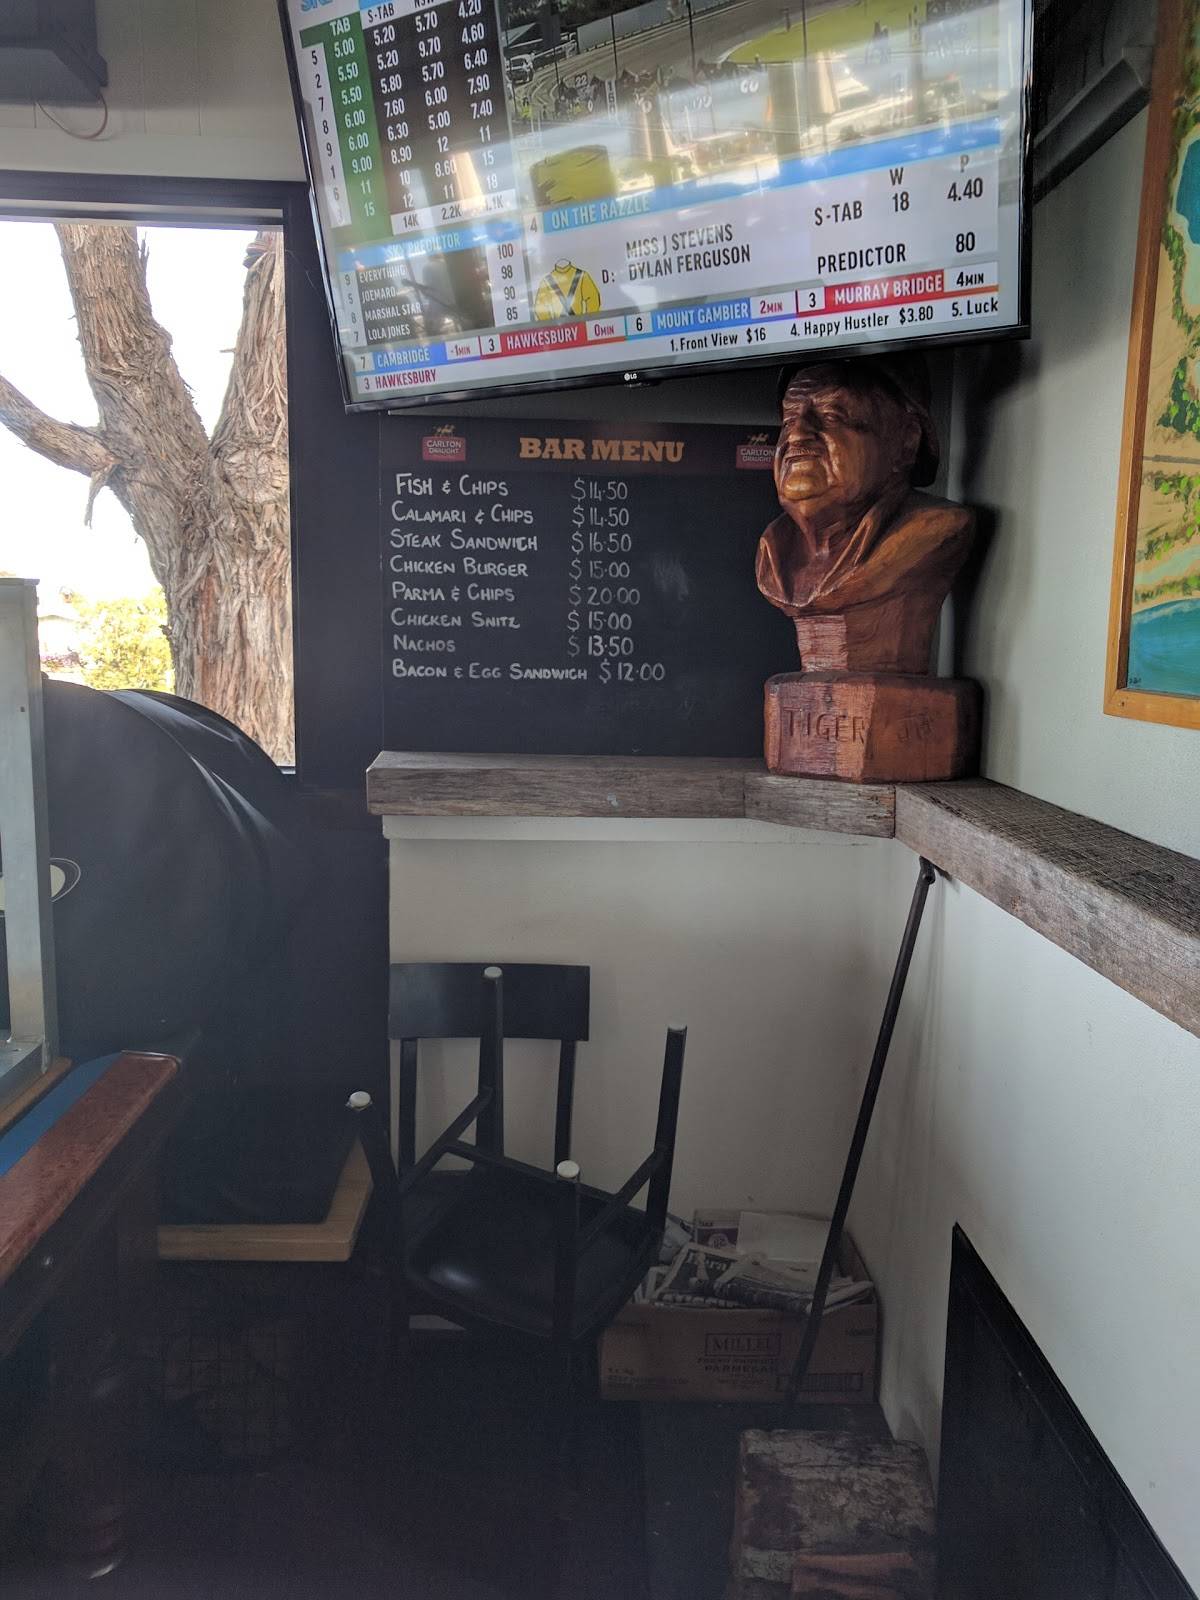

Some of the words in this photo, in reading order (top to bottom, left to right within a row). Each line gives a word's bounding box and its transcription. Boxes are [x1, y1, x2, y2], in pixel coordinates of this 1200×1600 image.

[311, 50, 318, 65] 5
[334, 37, 355, 58] 5.00
[373, 24, 396, 46] 5.20
[415, 11, 438, 33] 5.70
[458, 0, 482, 18] 4.20
[329, 17, 351, 37] TAB
[367, 2, 395, 23] S-TAB
[315, 73, 322, 89] 2
[337, 61, 359, 82] 5.50
[377, 49, 399, 71] 5.20
[418, 36, 441, 58] 9.70
[461, 22, 485, 45] 4.60
[318, 96, 324, 112] 7
[341, 85, 362, 105] 5.50
[380, 73, 403, 94] 5.80
[421, 61, 444, 82] 5.70
[464, 48, 488, 70] 6.40
[322, 119, 329, 135] 8
[344, 109, 366, 129] 6.00
[383, 97, 405, 118] 7.60
[425, 86, 448, 107] 6.00
[467, 73, 490, 96] 7.90
[326, 142, 333, 157] 9
[348, 132, 369, 152] 6.00
[387, 121, 409, 141] 6.30
[428, 110, 451, 130] 5.00
[470, 99, 493, 120] 7.40
[330, 165, 336, 179] 1
[351, 155, 373, 174] 9.00
[390, 145, 412, 165] 8.90
[437, 136, 449, 153] 12
[479, 124, 491, 143] 11
[360, 179, 372, 195] 11
[399, 169, 411, 186] 10
[434, 159, 457, 178] 8.60
[482, 150, 495, 166] 15
[889, 167, 905, 186] W
[959, 154, 970, 173] P
[364, 201, 376, 217] 15
[402, 192, 414, 209] 12
[442, 183, 455, 200] 11
[486, 173, 498, 190] 18
[814, 200, 863, 227] S-TAB
[892, 191, 910, 213] 18
[947, 177, 984, 202] 4.40
[402, 213, 420, 229] 14K
[441, 203, 462, 220] 2.2K
[529, 217, 538, 233] 4
[551, 208, 570, 230] ON
[571, 203, 597, 226] THE
[600, 194, 651, 221] RAZZLE
[497, 243, 514, 260] 100
[625, 236, 660, 260] MISS
[662, 235, 668, 255] J
[671, 223, 733, 251] STEVENS
[817, 243, 907, 275] PREDICTOR
[955, 231, 976, 254] 80
[501, 265, 513, 280] 98
[602, 268, 616, 285] D:
[628, 257, 674, 282] DYLAN
[677, 244, 751, 273] FERGUSON
[360, 356, 366, 369] 7
[377, 348, 431, 368] CAMBRIDGE
[488, 338, 495, 352] 3
[506, 326, 579, 350] HAWKESBURY
[635, 317, 643, 332] 6
[656, 310, 695, 330] MOUNT
[697, 302, 750, 323] GAMBIER
[808, 292, 817, 308] 3
[834, 281, 889, 305] MURRAY
[893, 274, 944, 297] BRIDGE
[364, 305, 401, 322] MARSHAL
[401, 302, 422, 316] STAR
[503, 286, 516, 300] 90
[353, 331, 359, 343] 7
[367, 327, 387, 341] LOLA
[387, 323, 411, 339] JONES
[506, 307, 518, 320] 85
[364, 378, 371, 390] 3
[375, 368, 437, 390] HAWKESBURY
[680, 335, 708, 351] Front
[710, 332, 738, 347] View
[746, 327, 767, 345] $16
[790, 323, 801, 338] 4.
[804, 318, 841, 338] Happy
[844, 312, 890, 331] Hustler
[899, 305, 934, 325] $3.80
[951, 302, 963, 317] 5.
[966, 297, 999, 315] Luck
[426, 440, 462, 449] CARLTON
[519, 437, 586, 460] BAR
[591, 439, 685, 463] MENU
[740, 448, 775, 457] CARLTON
[396, 472, 433, 496] FISH
[441, 480, 451, 495] &
[459, 474, 509, 497] CHIPS
[391, 500, 466, 524] CALAMARI
[474, 508, 485, 525] &
[490, 503, 534, 525] CHIPS
[390, 528, 442, 549] STEAK
[449, 527, 538, 551] SANDWICH
[390, 554, 456, 575] CHICKEN
[463, 556, 528, 577] BURGER
[392, 581, 446, 602] PARMA
[450, 585, 461, 602] &
[467, 583, 515, 602] CHIPS
[390, 607, 462, 627] CHICKEN
[471, 611, 521, 630] SNITZ
[393, 634, 456, 653] NACHOS
[392, 658, 447, 679] BACON
[453, 665, 463, 679] &
[469, 662, 502, 680] EGG
[509, 663, 588, 681] SANDWICH
[783, 706, 868, 744] TIGER
